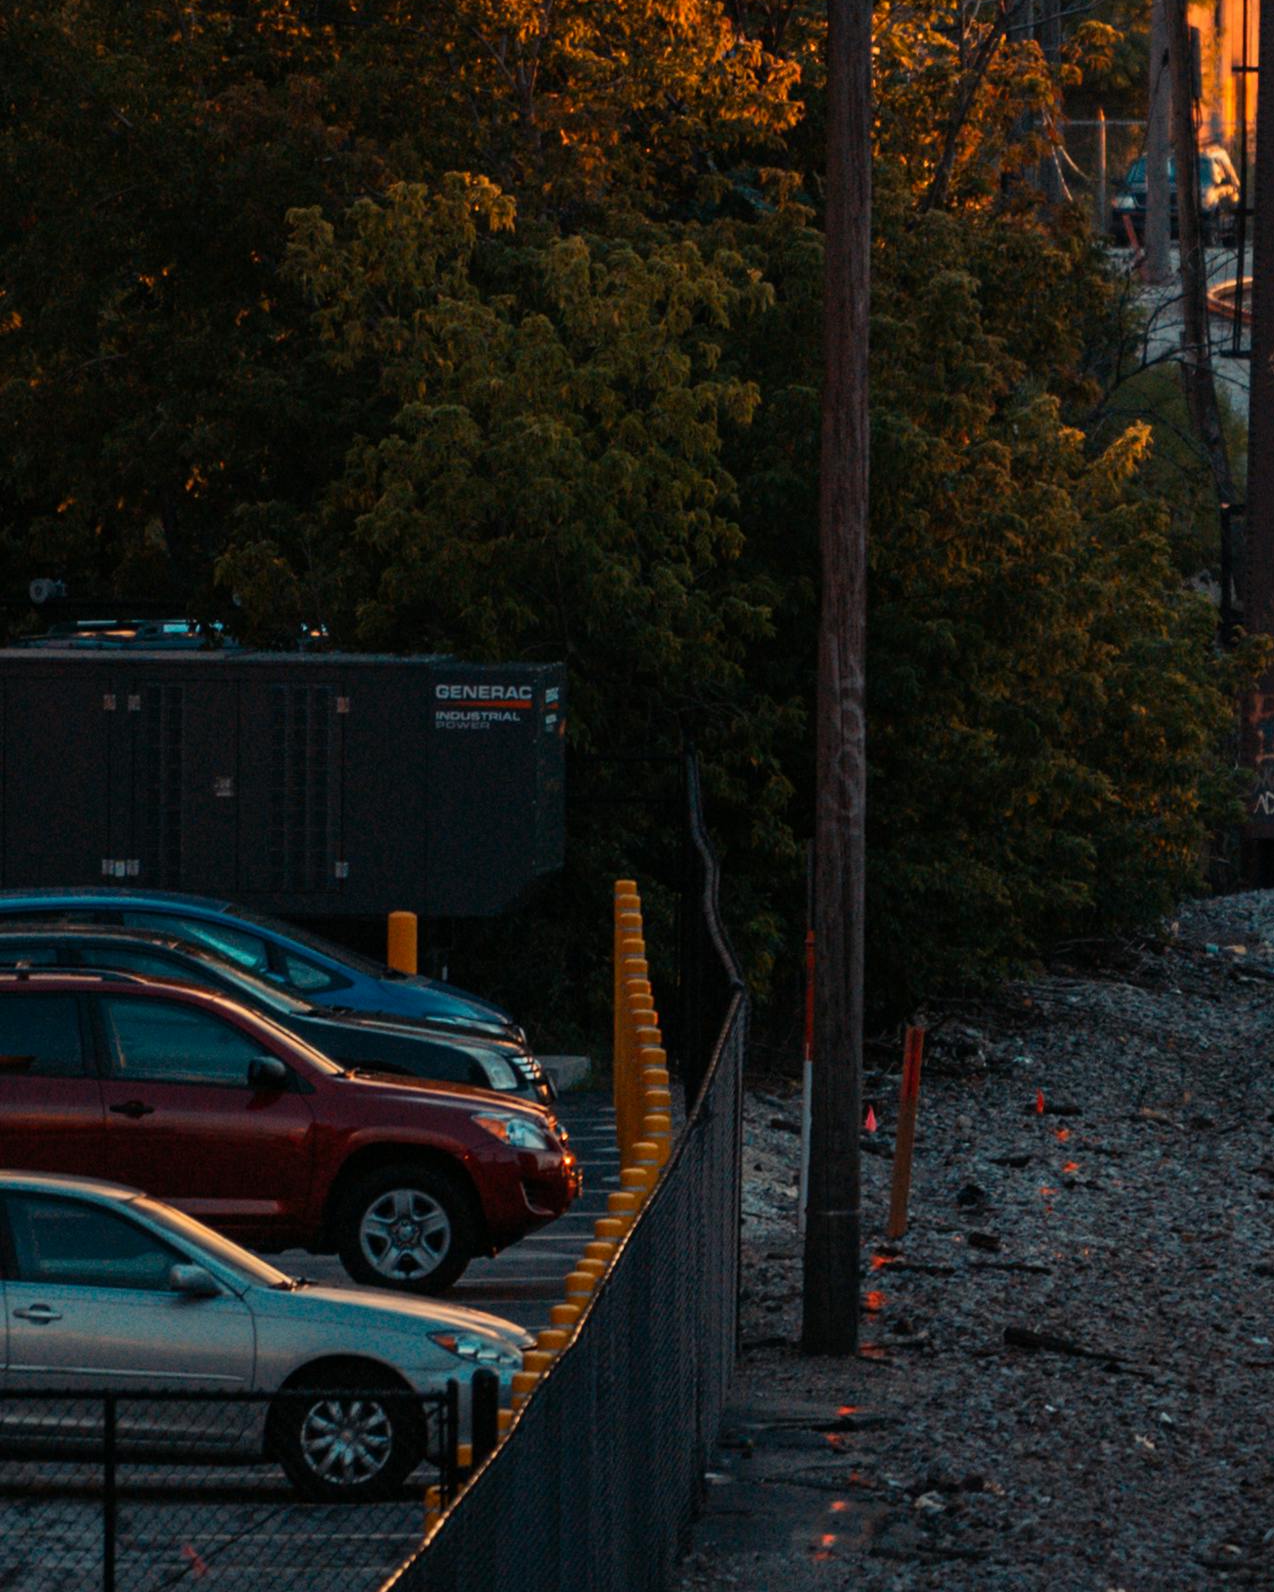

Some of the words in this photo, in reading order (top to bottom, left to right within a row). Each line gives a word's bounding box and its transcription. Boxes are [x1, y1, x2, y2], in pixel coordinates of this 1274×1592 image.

[434, 684, 533, 699] GENERAC
[435, 711, 521, 721] INDUSTRIAL
[435, 721, 491, 730] POWER
